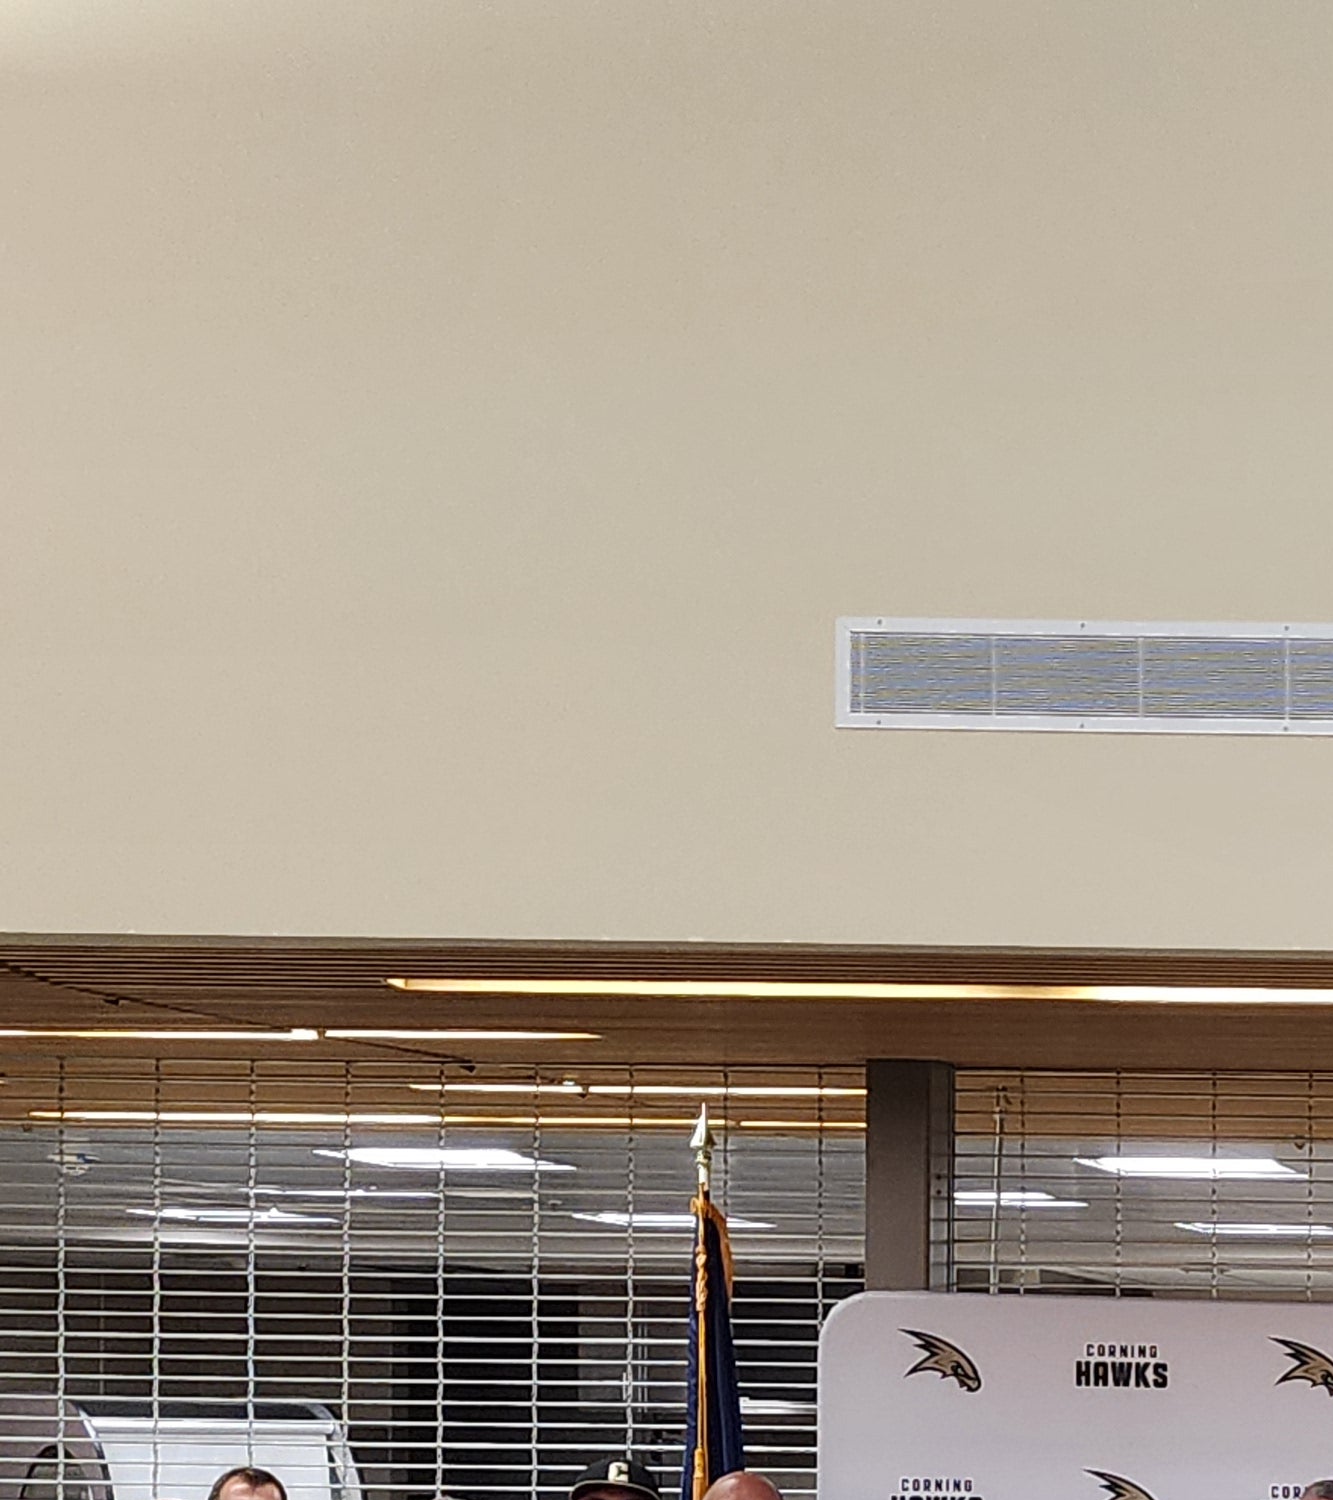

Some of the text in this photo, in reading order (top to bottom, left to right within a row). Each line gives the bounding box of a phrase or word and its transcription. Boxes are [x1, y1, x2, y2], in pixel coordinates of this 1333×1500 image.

[1086, 1344, 1157, 1358] CORNING
[1075, 1361, 1168, 1388] HAWKS
[901, 1479, 972, 1493] CORNING
